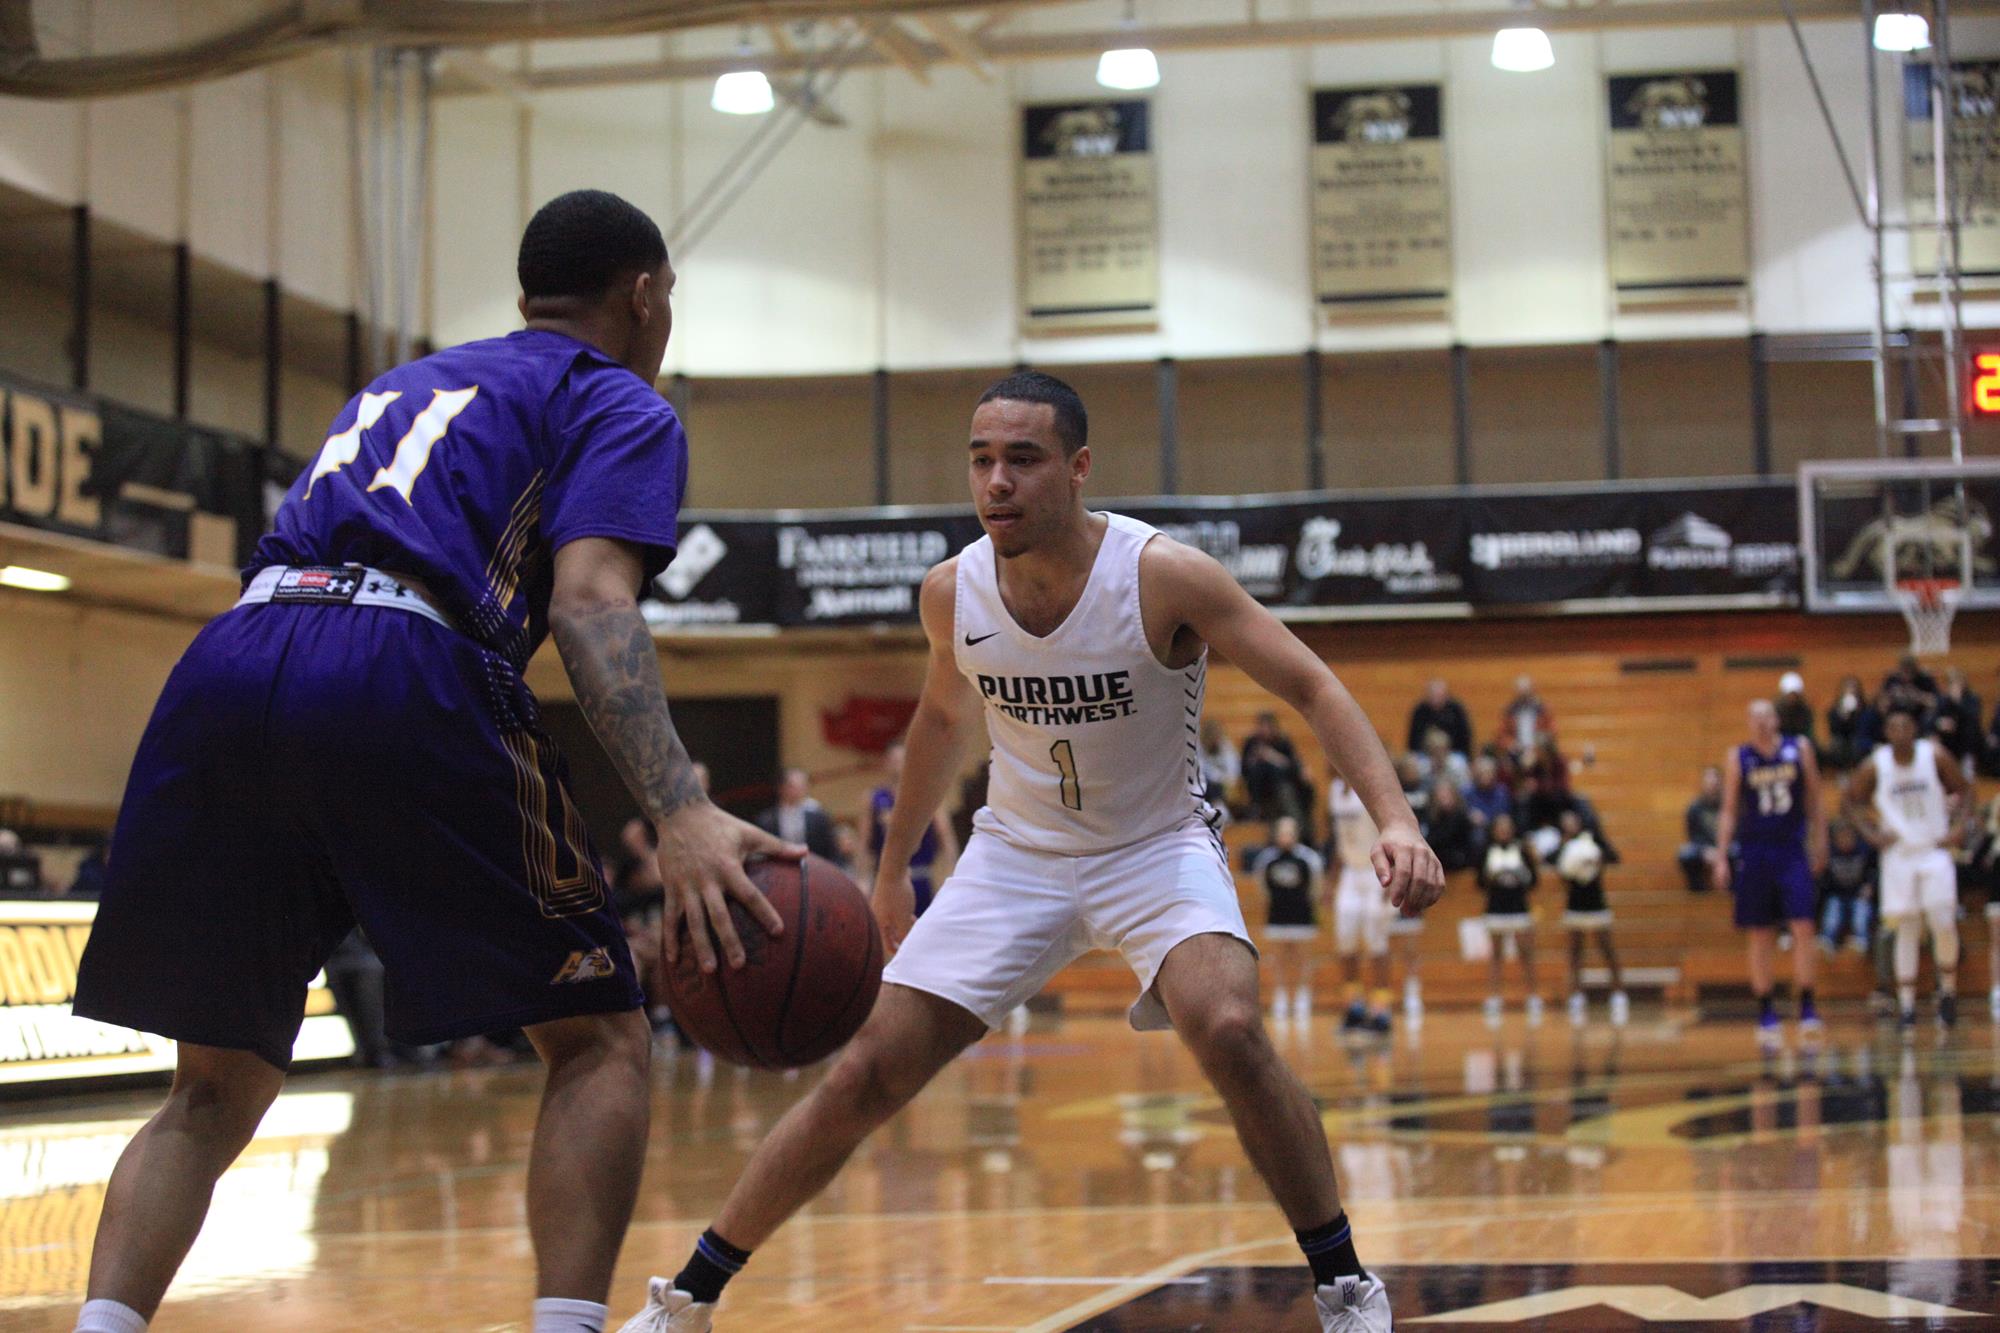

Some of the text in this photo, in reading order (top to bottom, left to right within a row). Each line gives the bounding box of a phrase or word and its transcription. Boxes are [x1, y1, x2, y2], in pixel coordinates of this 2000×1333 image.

[303, 384, 479, 507] 11
[977, 671, 1133, 705] PURDUE
[1050, 740, 1081, 811] 1
